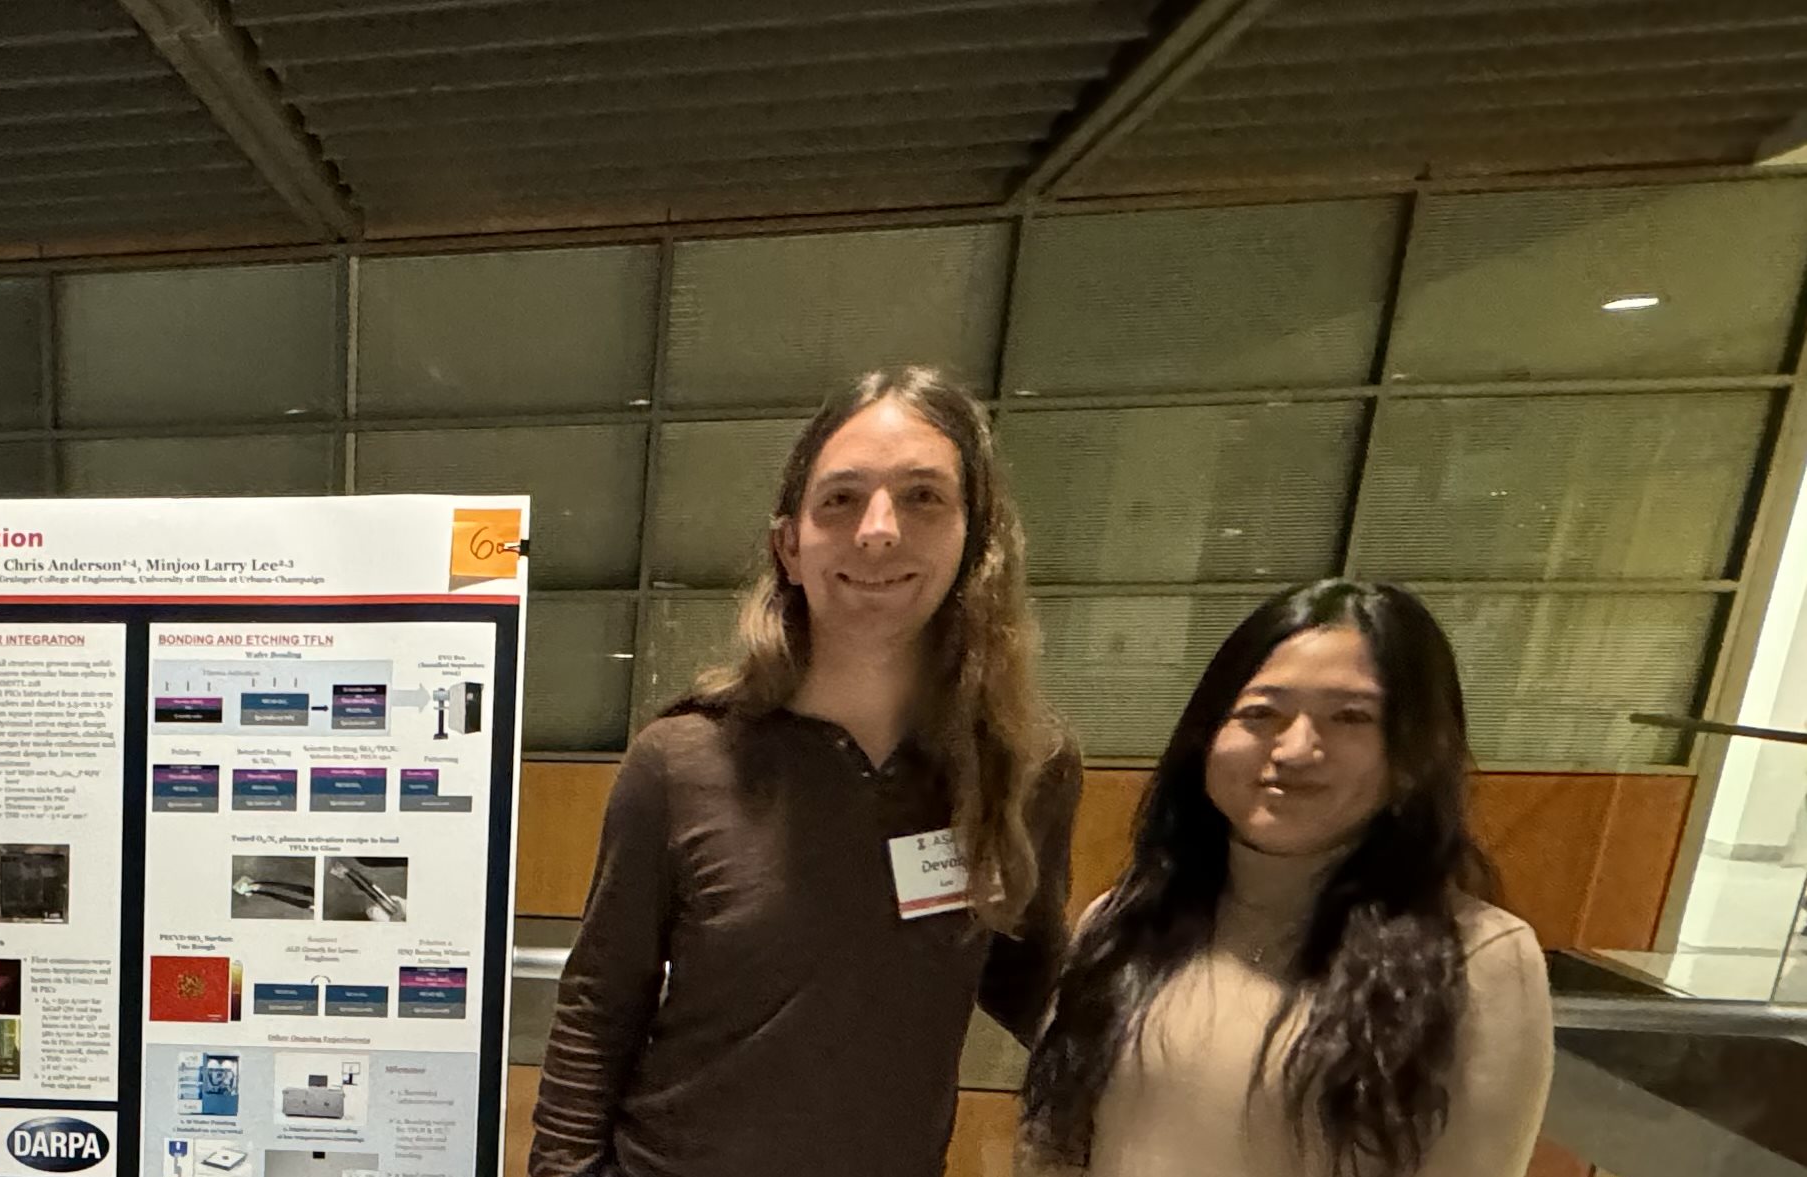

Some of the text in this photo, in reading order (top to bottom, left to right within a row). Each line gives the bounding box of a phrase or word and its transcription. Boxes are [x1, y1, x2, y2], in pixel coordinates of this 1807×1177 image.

[4, 557, 44, 572] Chris
[145, 557, 200, 574] Minjoo
[205, 557, 246, 574] Larry
[6, 634, 85, 646] INTEGRATION
[158, 634, 334, 645] BONDING AND ETCHING TFLN
[13, 1129, 102, 1160] DARPA
